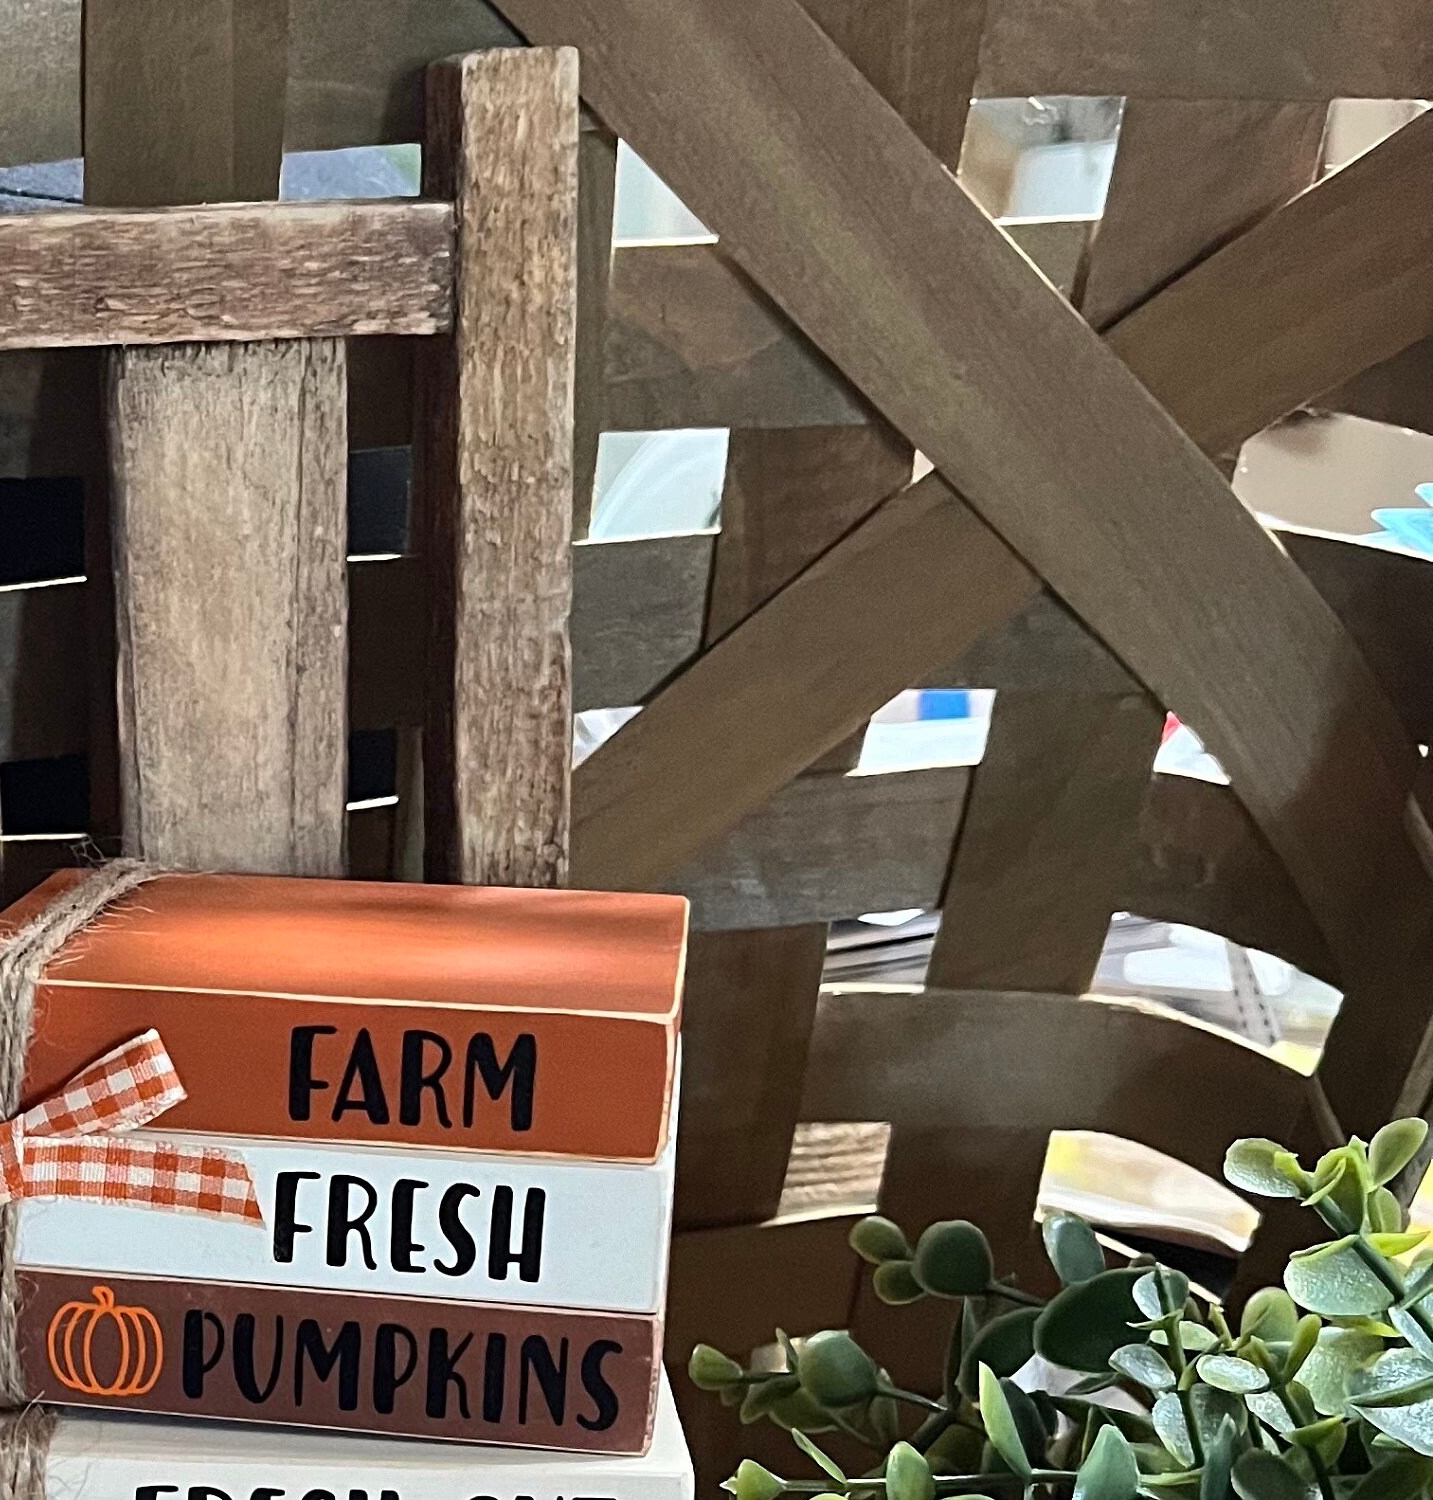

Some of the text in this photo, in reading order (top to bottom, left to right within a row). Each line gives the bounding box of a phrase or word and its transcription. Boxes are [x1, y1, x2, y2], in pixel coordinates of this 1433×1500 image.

[287, 1024, 538, 1132] FARM
[272, 1170, 547, 1284] FRESH
[181, 1307, 624, 1432] PUMPKINS
